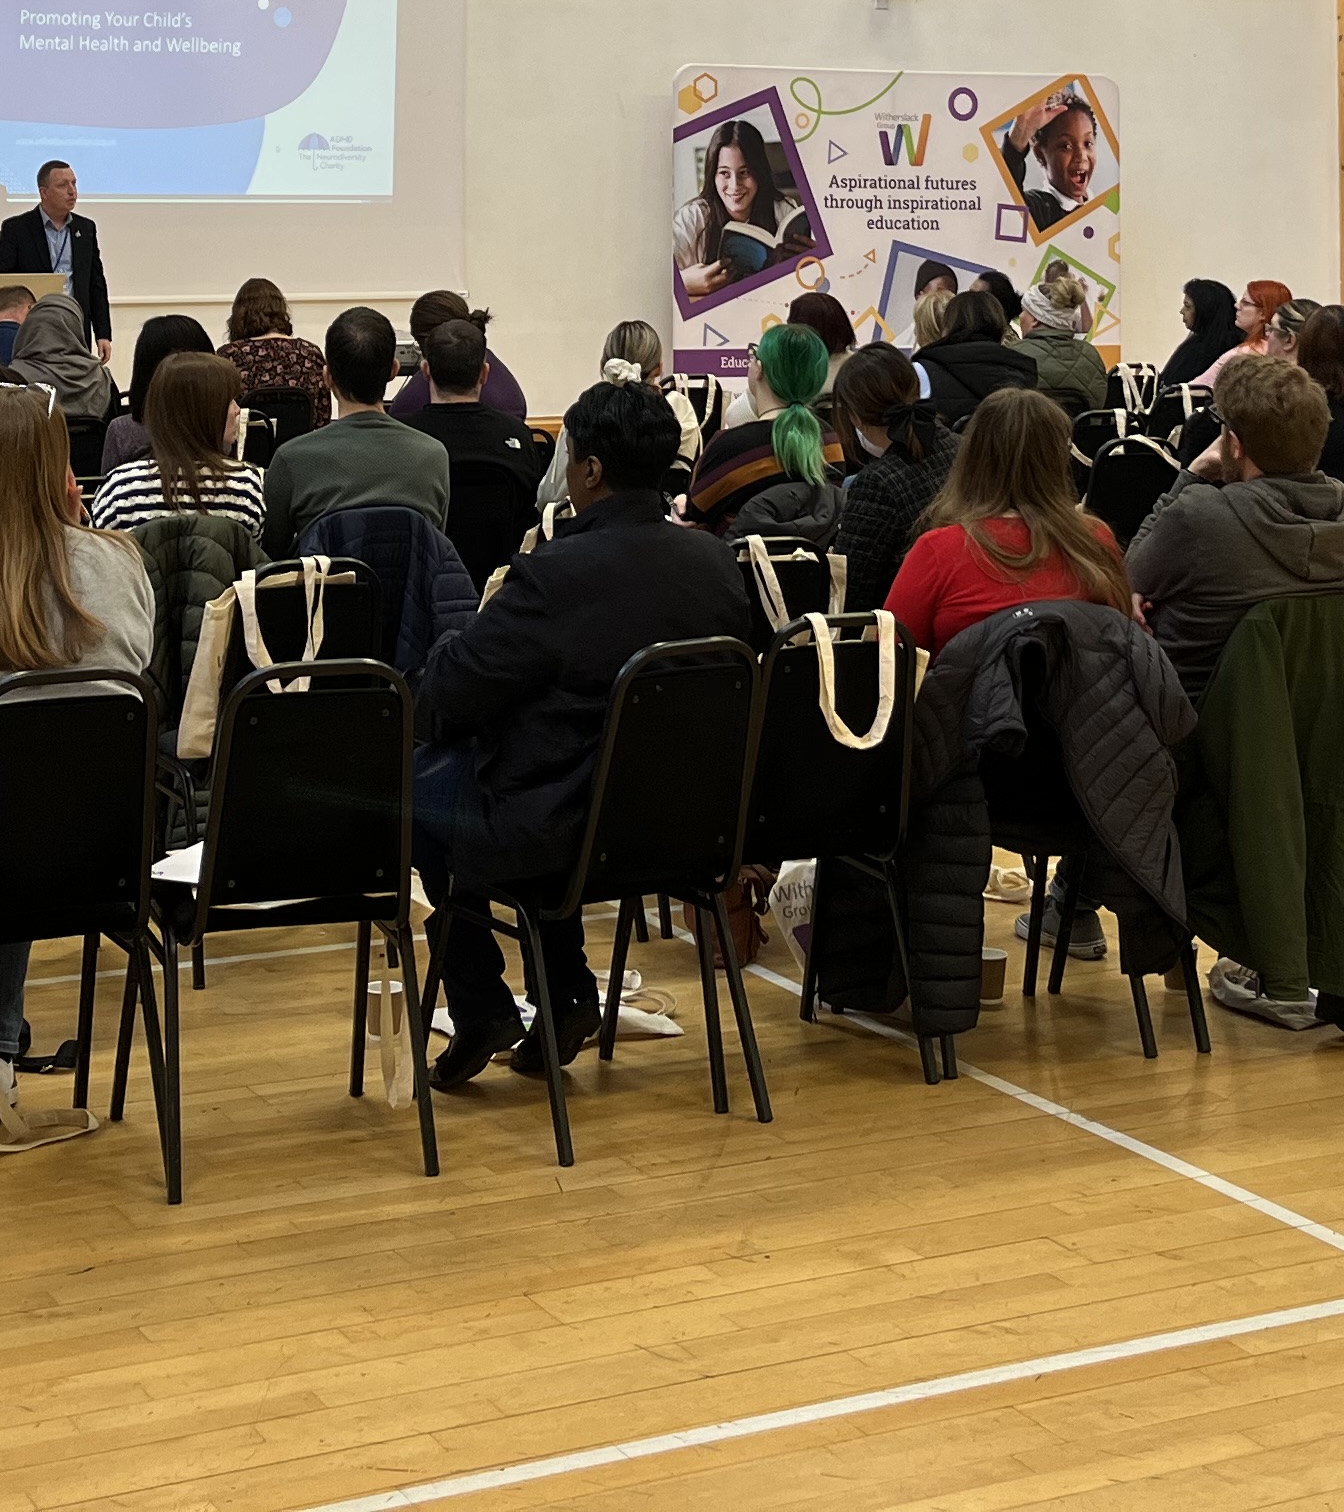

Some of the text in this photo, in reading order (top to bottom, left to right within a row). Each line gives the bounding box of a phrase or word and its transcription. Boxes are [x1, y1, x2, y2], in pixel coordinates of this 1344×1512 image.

[20, 9, 192, 30] Promoting Your Child’s
[19, 34, 241, 57] Mental Health and Wellbeing
[874, 113, 919, 122] Witherslack
[828, 174, 977, 192] Aspirational futures
[823, 194, 982, 213] through inspirational
[867, 215, 940, 231] education
